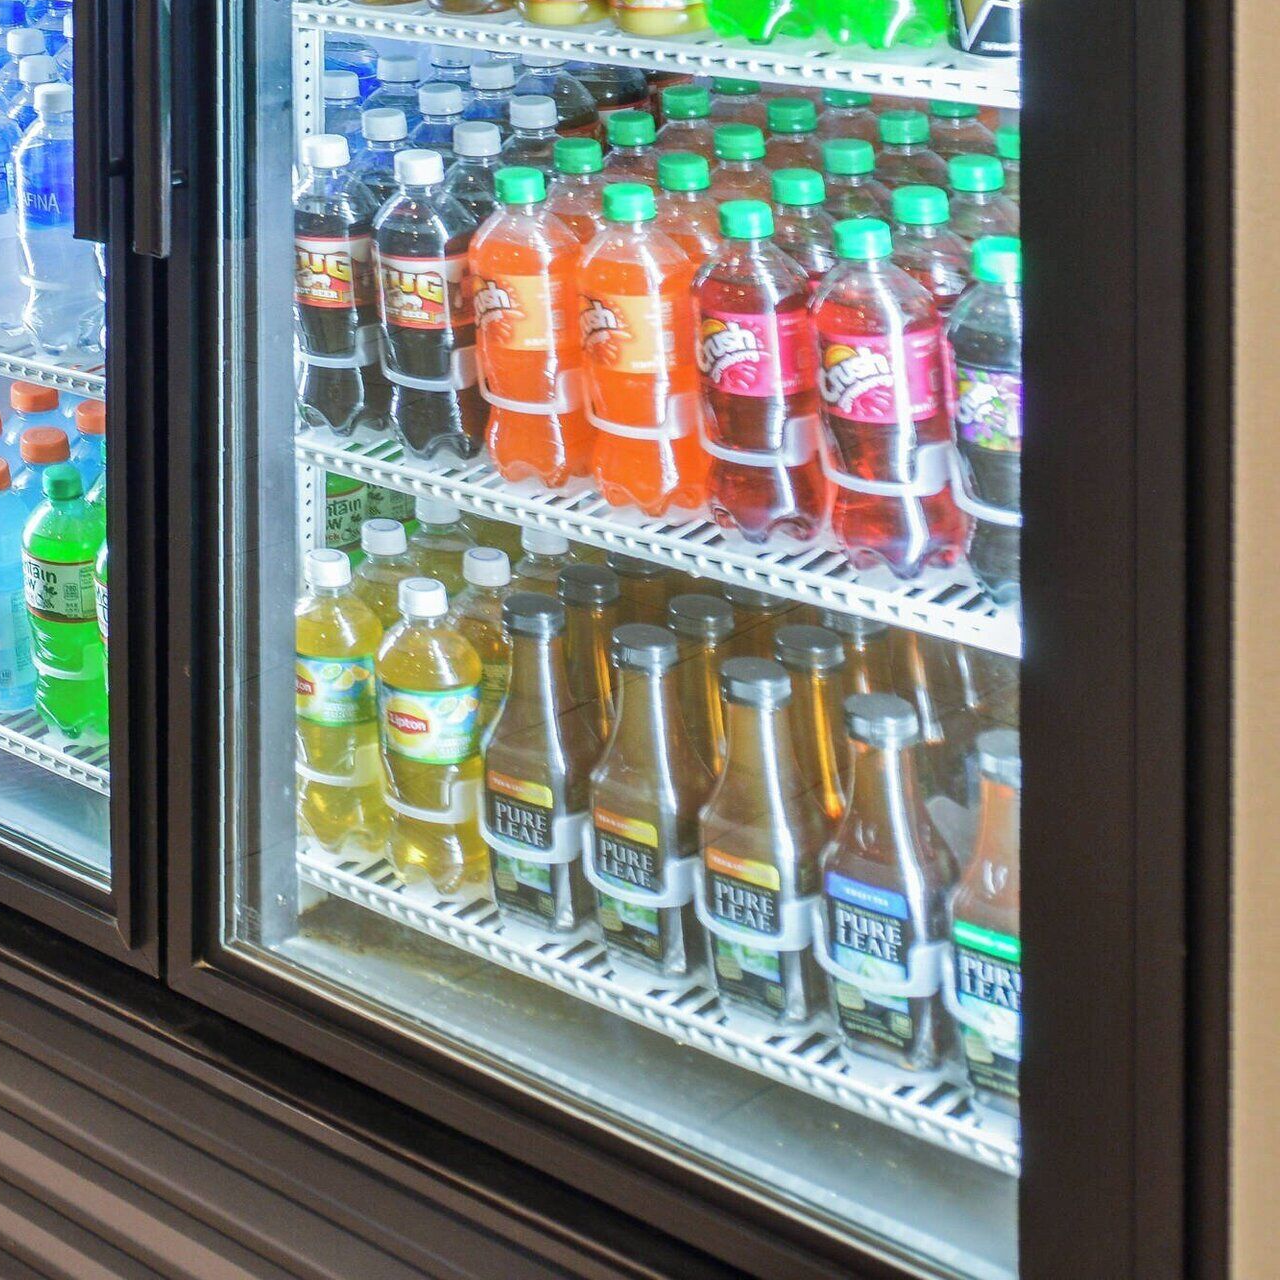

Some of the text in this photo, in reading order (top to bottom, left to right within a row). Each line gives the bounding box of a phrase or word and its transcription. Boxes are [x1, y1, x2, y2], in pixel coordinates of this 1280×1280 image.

[819, 346, 892, 404] Crush
[389, 712, 427, 732] Lipton
[496, 800, 548, 833] PURE
[496, 818, 545, 848] LEAF
[600, 838, 654, 871] PURE
[601, 856, 651, 888] LEAF
[713, 880, 775, 917] PURE
[715, 898, 772, 933] LEAF
[837, 909, 903, 946] PURE
[838, 927, 899, 962] LEAF
